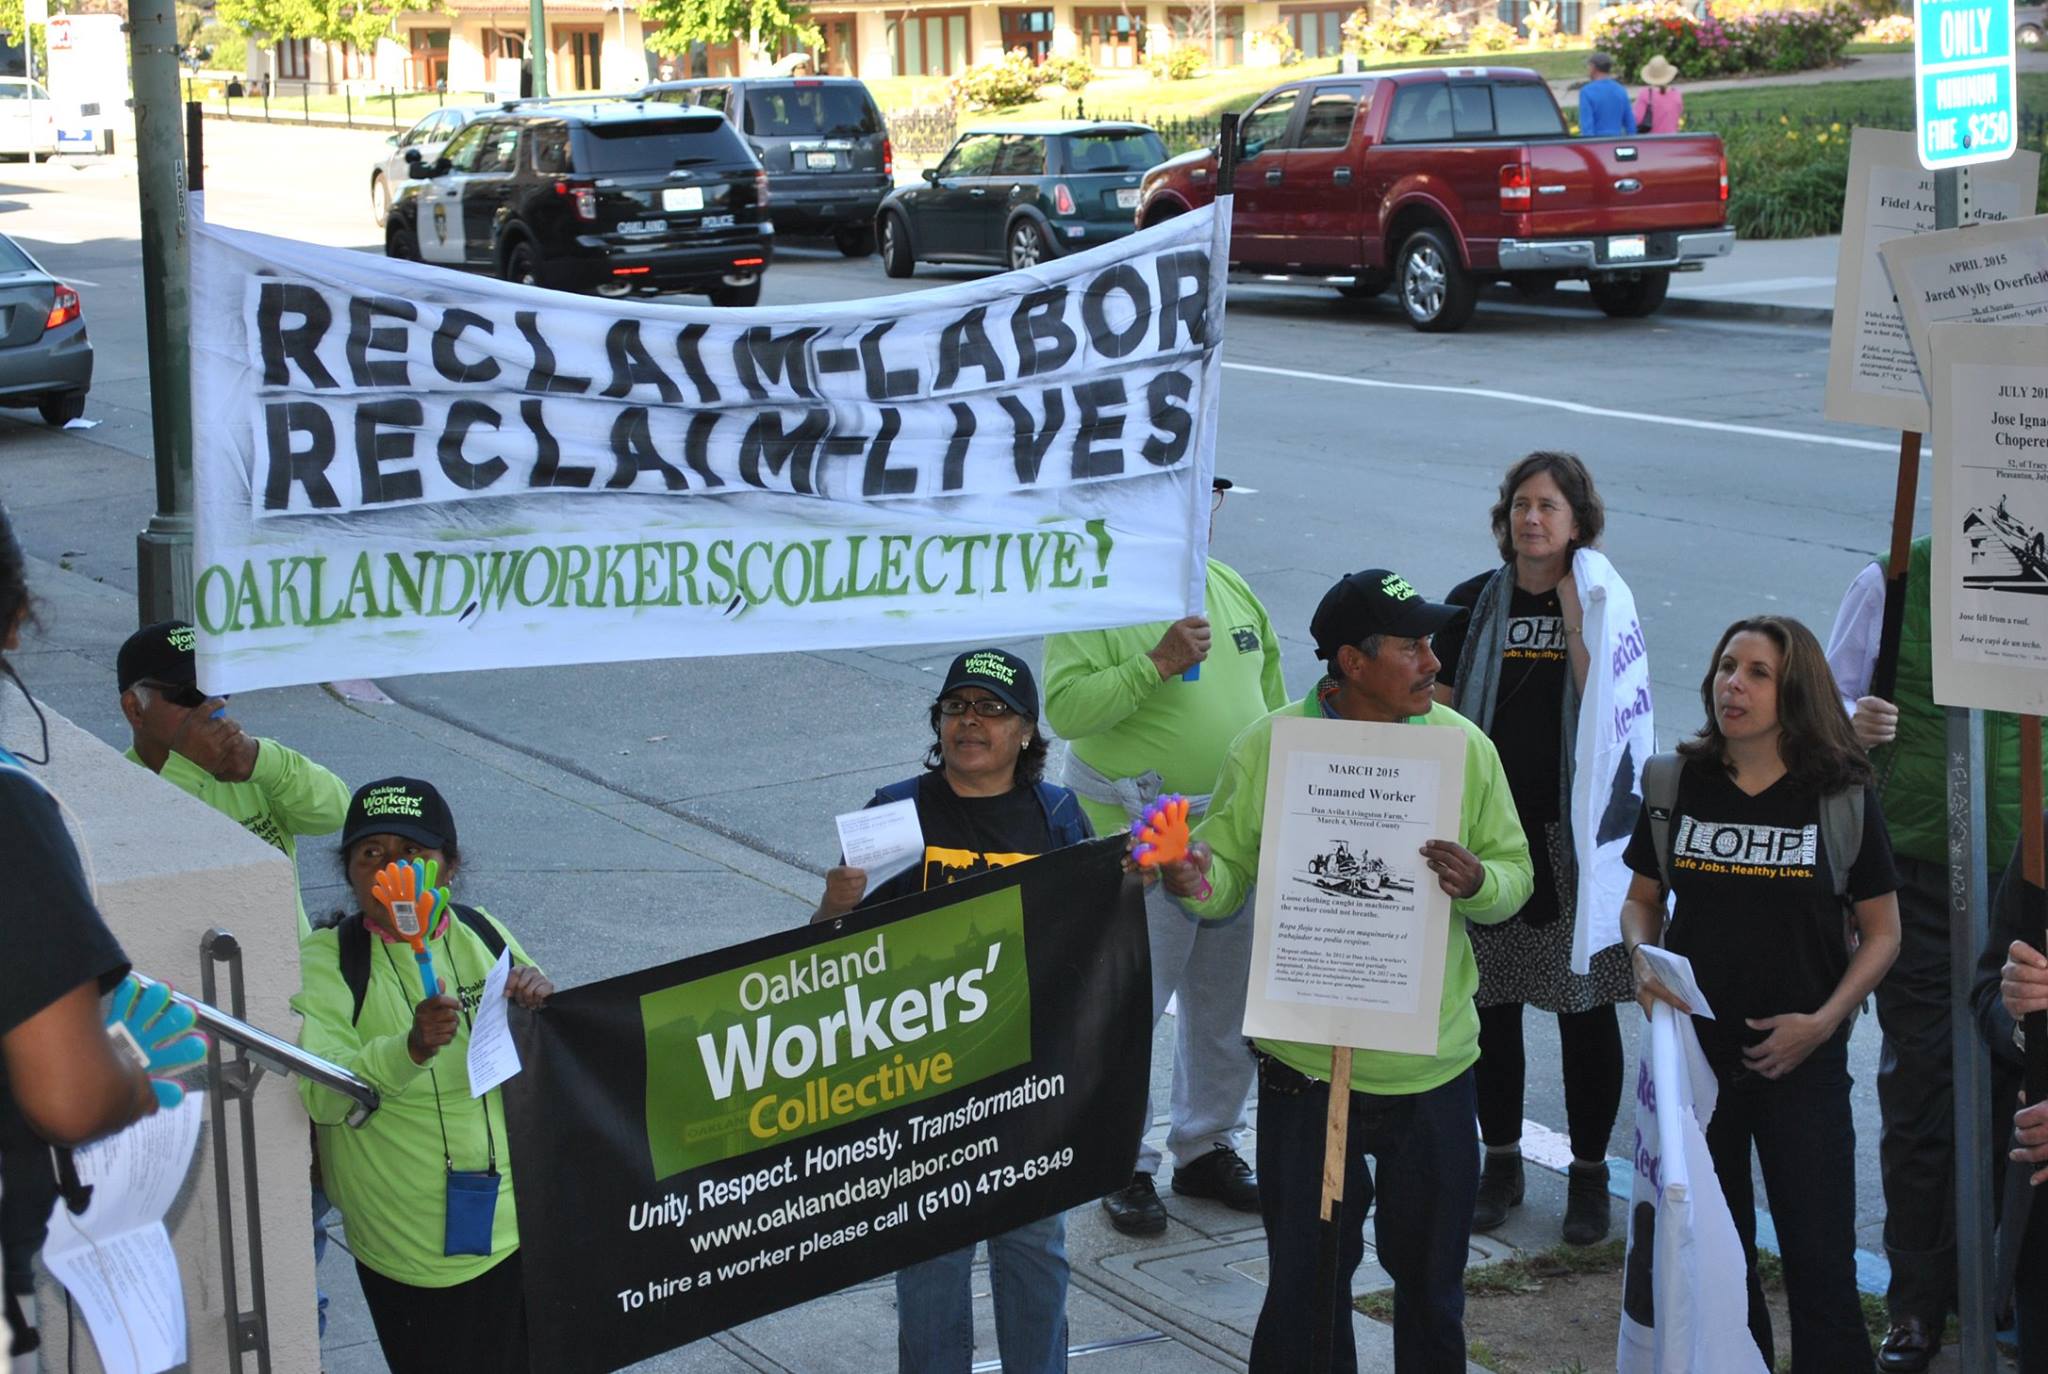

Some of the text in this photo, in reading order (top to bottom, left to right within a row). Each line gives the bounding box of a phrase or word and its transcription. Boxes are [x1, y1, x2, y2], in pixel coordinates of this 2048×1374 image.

[1940, 8, 1991, 58] ONLY
[1927, 110, 2009, 151] FINE $250
[1881, 196, 1910, 210] Fidel
[702, 215, 735, 230] POLICE
[1949, 254, 2008, 274] APRIL 2015
[1925, 287, 1956, 303] Jared
[1998, 385, 2048, 399] JULY 201
[1992, 411, 2016, 425] Jose
[973, 652, 1005, 663] Oakland
[965, 658, 1017, 678] Workers'
[966, 666, 1014, 686] Collective
[1328, 764, 1400, 778] MARCH 2015
[363, 793, 423, 809] Workers'
[370, 786, 406, 796] Oakland
[1308, 784, 1416, 803] Unnamed Worker
[366, 804, 422, 817] Collective
[1684, 821, 1803, 861] LOHP
[1674, 858, 1814, 878] Safe Jobs. Healthy Lives.
[739, 934, 887, 1012] Oakland
[696, 942, 1001, 1101] Workers'
[748, 1051, 953, 1139] Collective
[628, 1074, 1066, 1233] Unity. Respect. Honesty. Transformation
[689, 1136, 999, 1254] www.oaklanddaylabor.com
[617, 1146, 1074, 1313] To hire a worker please call (510) 473-6349
